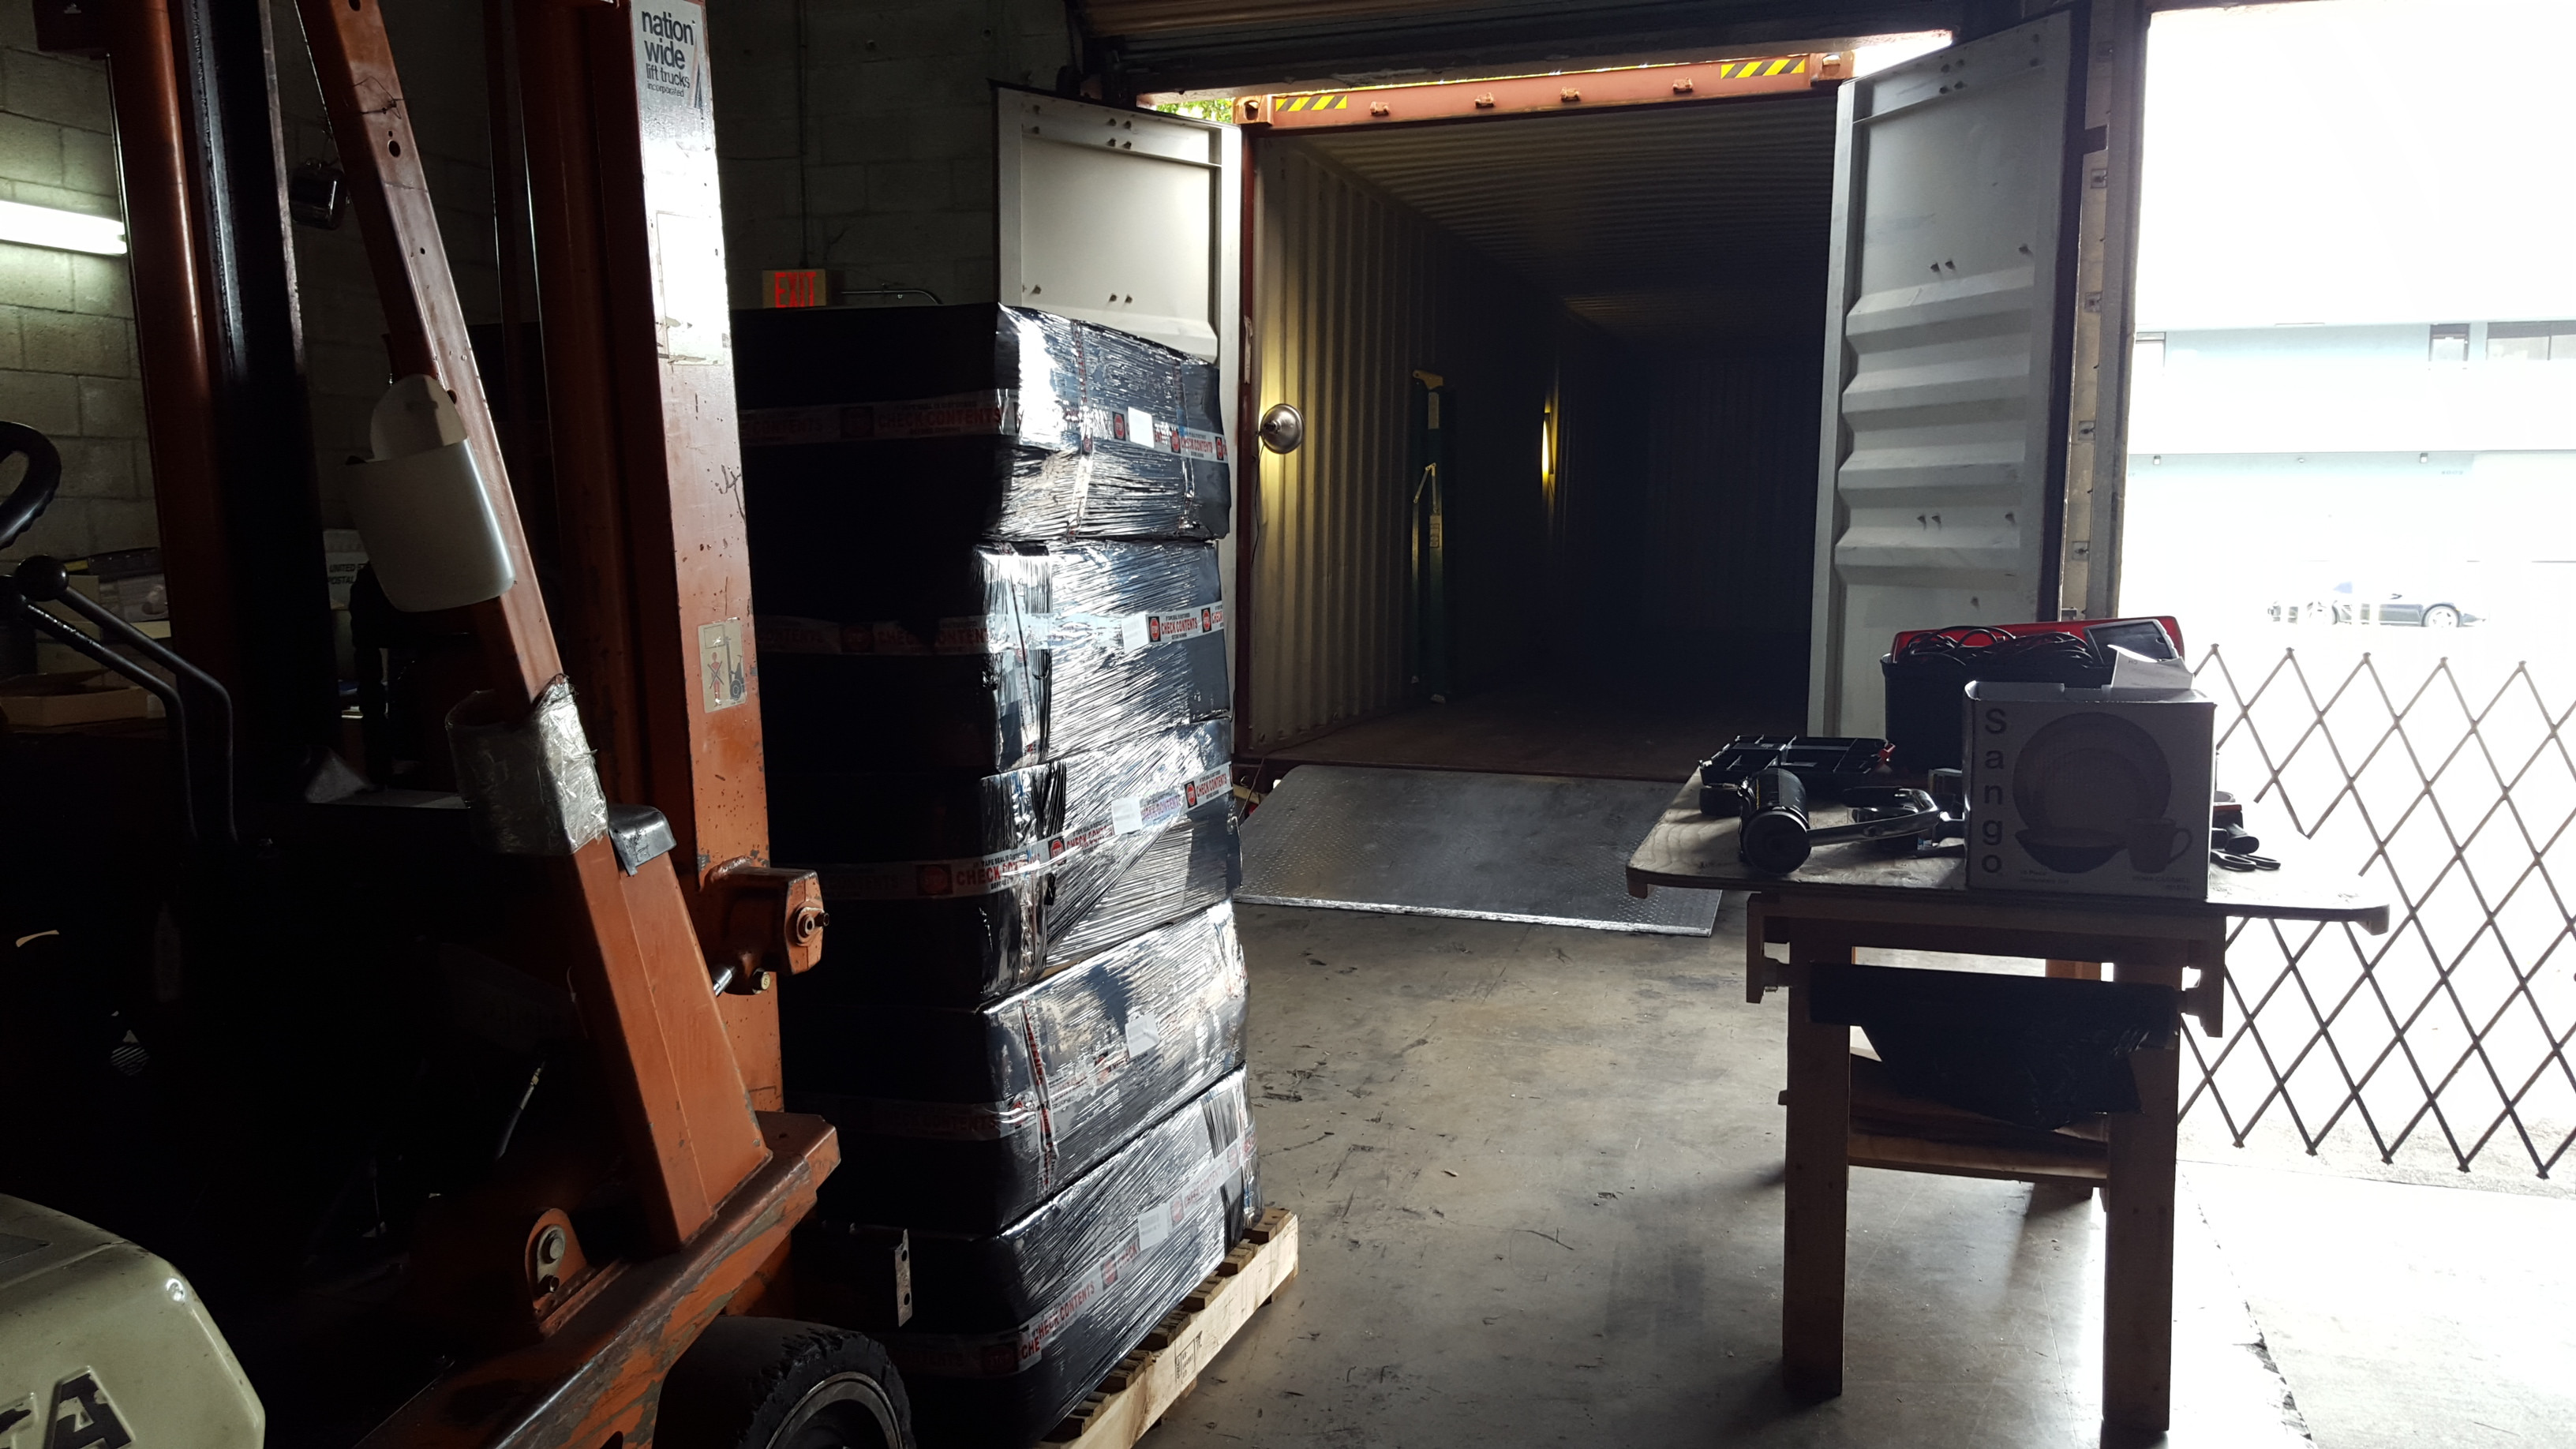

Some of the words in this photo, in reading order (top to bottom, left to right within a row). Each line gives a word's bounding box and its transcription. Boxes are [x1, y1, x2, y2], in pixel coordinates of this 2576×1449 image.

[642, 10, 695, 46] nation
[644, 37, 686, 70] wide
[646, 62, 660, 81] lift
[660, 66, 691, 89] trucks
[647, 80, 685, 98] incorporated
[774, 271, 817, 309] EXIT
[878, 410, 923, 429] CHECK
[927, 406, 1002, 427] CONTENTS
[329, 564, 356, 573] UNITED
[1161, 620, 1177, 635] CHECK
[1175, 616, 1198, 633] CONTENTS
[1196, 781, 1210, 797] CHECK
[1208, 773, 1227, 792] CONTENTS
[1981, 708, 2007, 874] Sango
[982, 857, 994, 867] TAPE
[994, 856, 1005, 865] SEAL
[957, 865, 1002, 887] CHECK
[1059, 1279, 1095, 1321] CONTENTS
